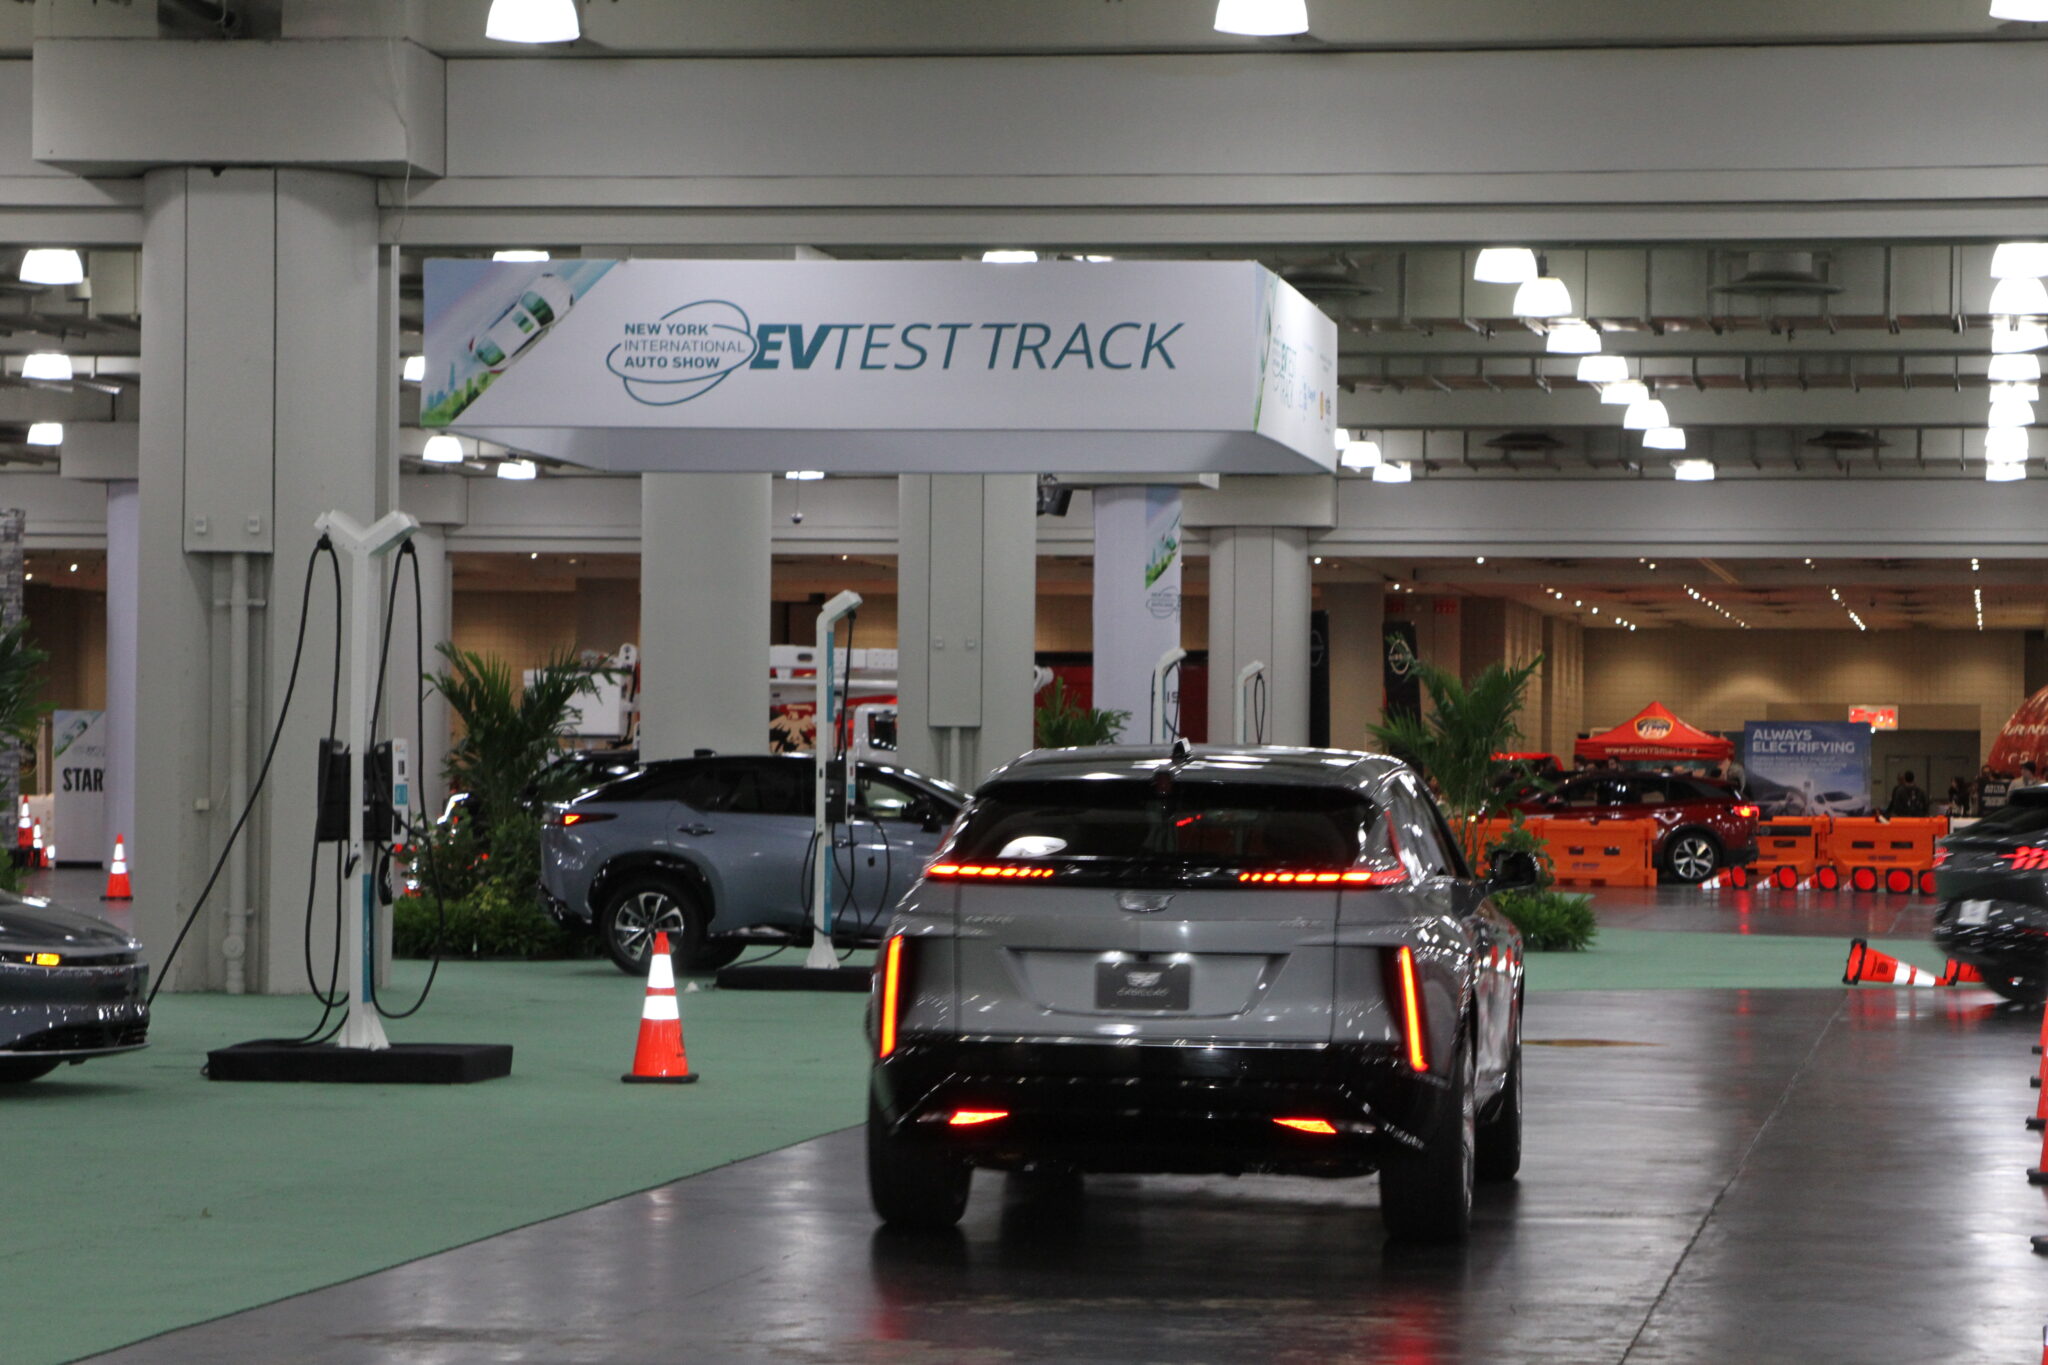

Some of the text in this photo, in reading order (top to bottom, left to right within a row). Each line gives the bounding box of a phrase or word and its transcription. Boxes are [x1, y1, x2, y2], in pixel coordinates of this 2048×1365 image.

[624, 323, 709, 336] NEW YORK
[624, 340, 746, 353] INTERNATIONAL
[624, 356, 720, 368] AUTO SHOW
[1752, 729, 1813, 741] ALWAYS
[1752, 741, 1855, 753] ELECTRIFYING
